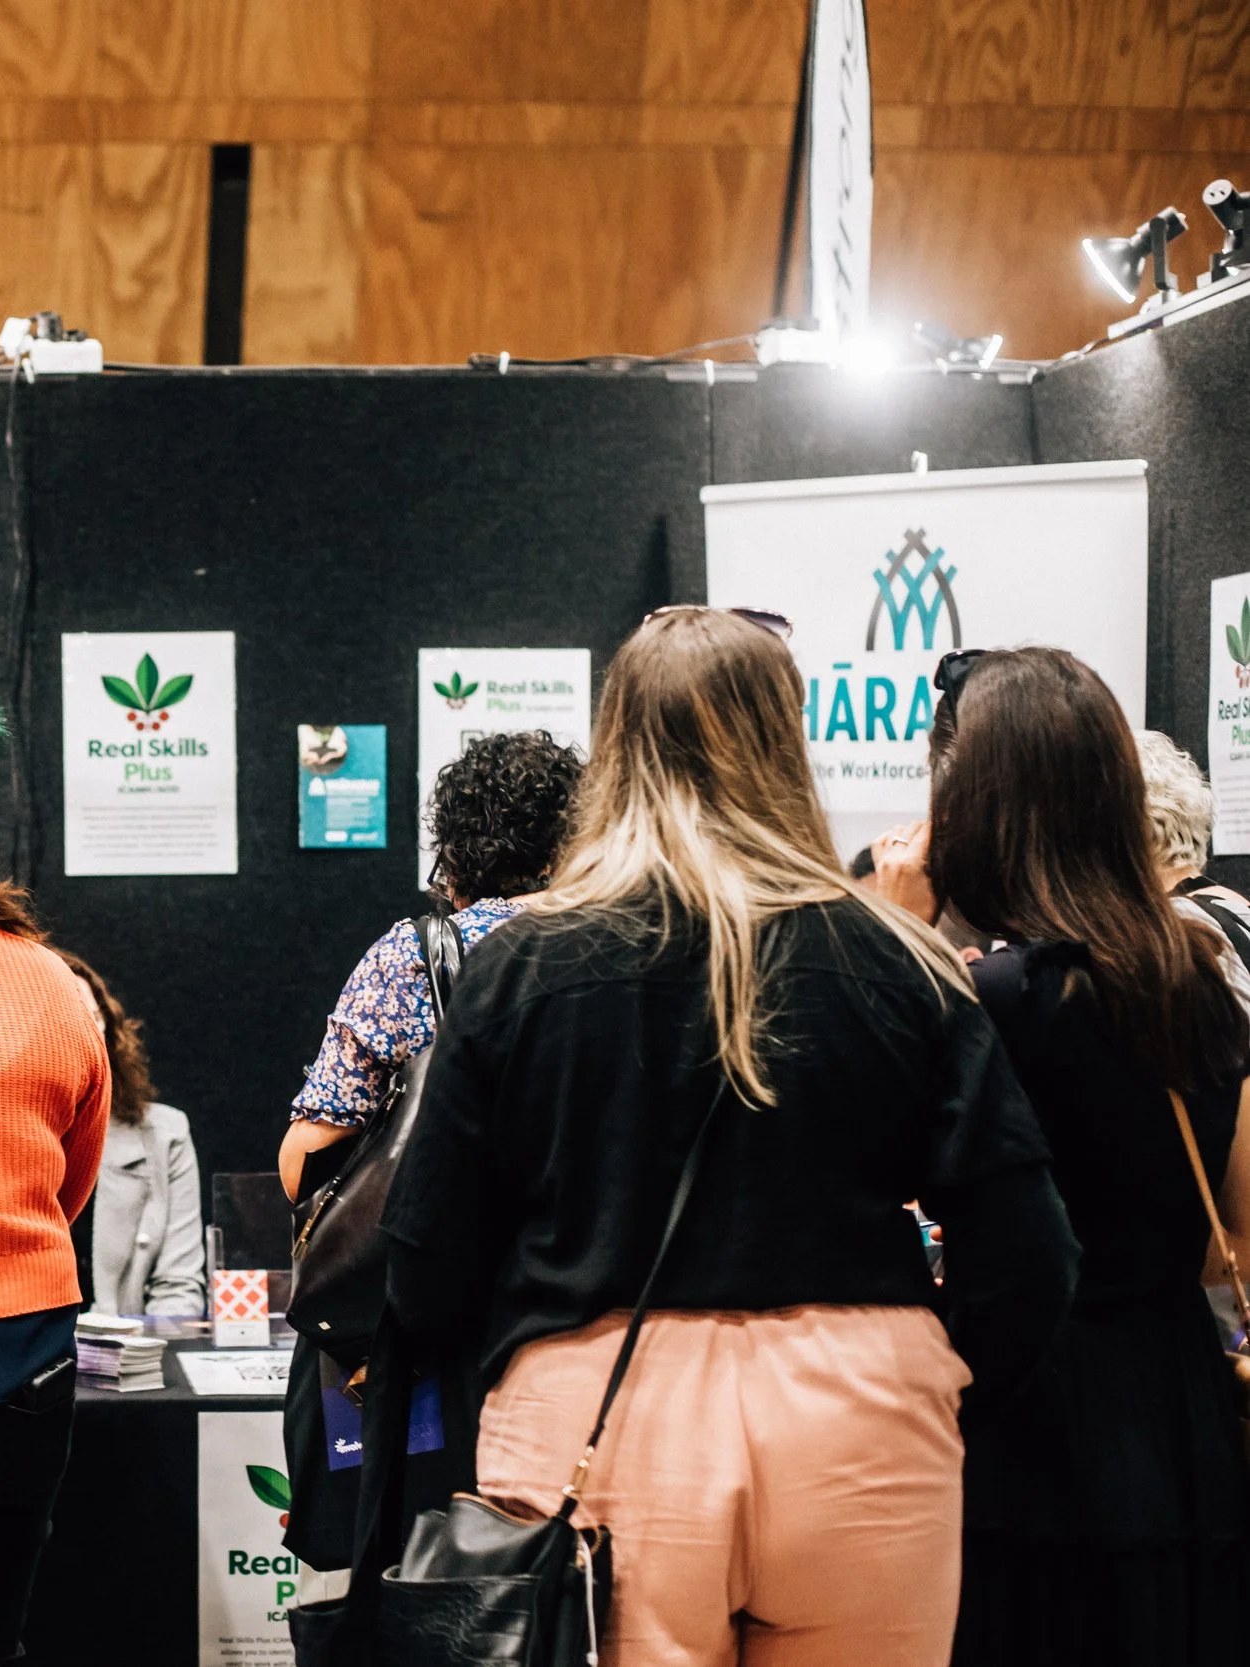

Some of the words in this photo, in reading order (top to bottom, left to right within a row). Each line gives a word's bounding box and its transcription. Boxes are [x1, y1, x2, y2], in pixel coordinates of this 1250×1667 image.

[486, 680, 526, 694] Real
[802, 662, 934, 741] HĀRA
[1218, 696, 1242, 720] Real
[88, 738, 142, 757] Real
[148, 737, 209, 757] Skills
[124, 763, 172, 781] Plus
[814, 763, 834, 777] he
[841, 762, 924, 779] Workforce
[229, 1550, 299, 1576] Real
[267, 1611, 288, 1622] ICA
